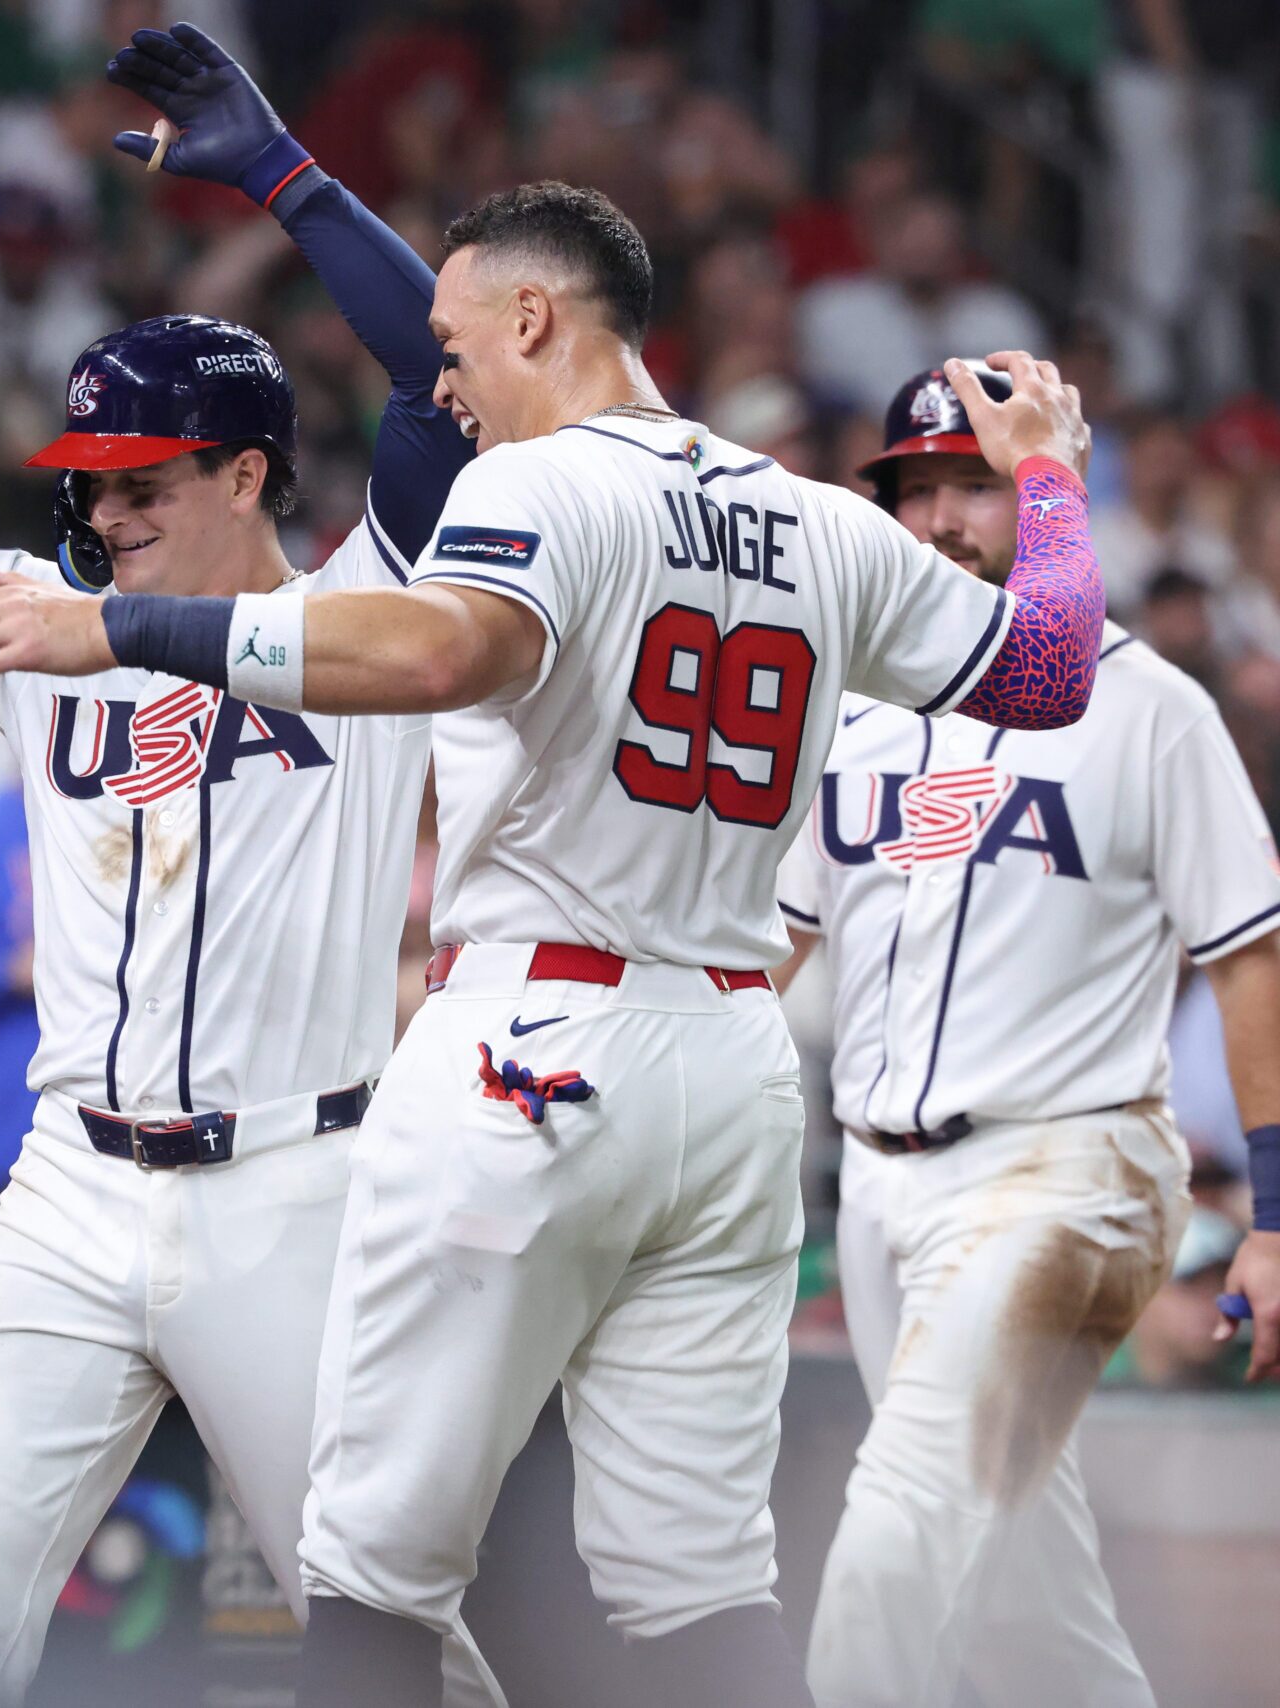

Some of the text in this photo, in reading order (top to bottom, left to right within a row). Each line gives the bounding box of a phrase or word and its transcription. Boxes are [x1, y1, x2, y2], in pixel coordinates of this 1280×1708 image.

[269, 645, 286, 667] 99
[612, 600, 818, 831] 99
[46, 680, 336, 809] USA
[813, 764, 1091, 881] USA
